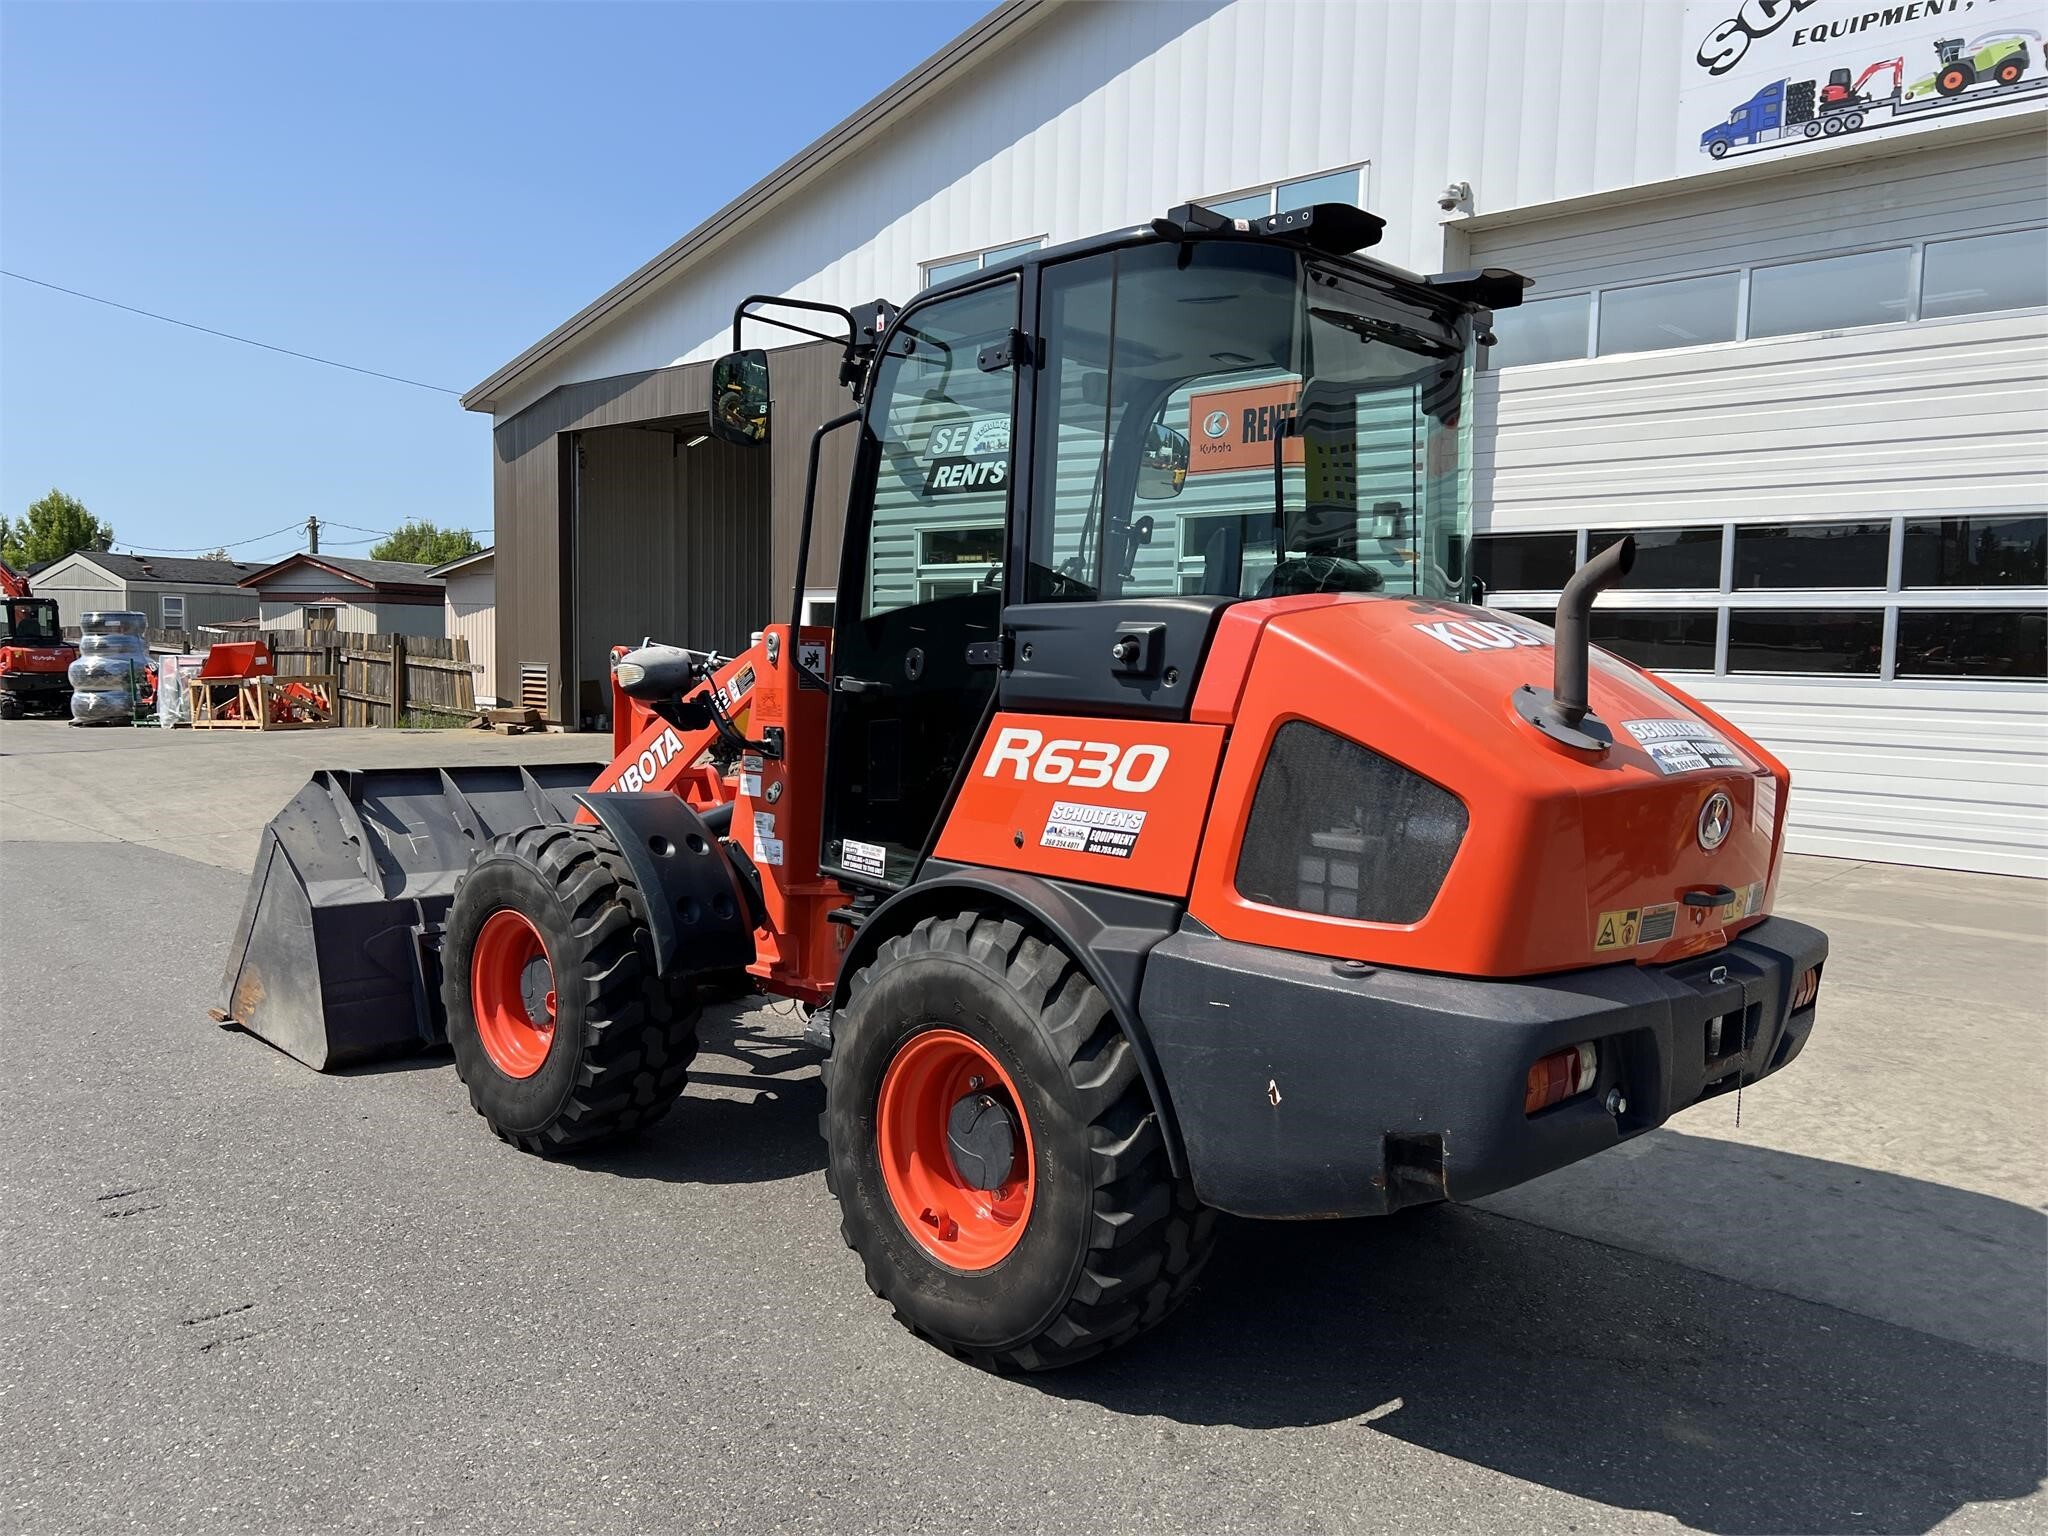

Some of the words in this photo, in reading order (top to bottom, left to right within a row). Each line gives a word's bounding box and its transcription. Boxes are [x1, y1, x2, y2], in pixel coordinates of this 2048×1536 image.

[932, 426, 970, 454] SE
[1200, 442, 1231, 454] Kubota
[932, 460, 1007, 488] RENTS
[983, 727, 1170, 793] R630
[1052, 805, 1142, 829] SCHOLTEN'S
[1089, 829, 1137, 846] EQUIPMENT
